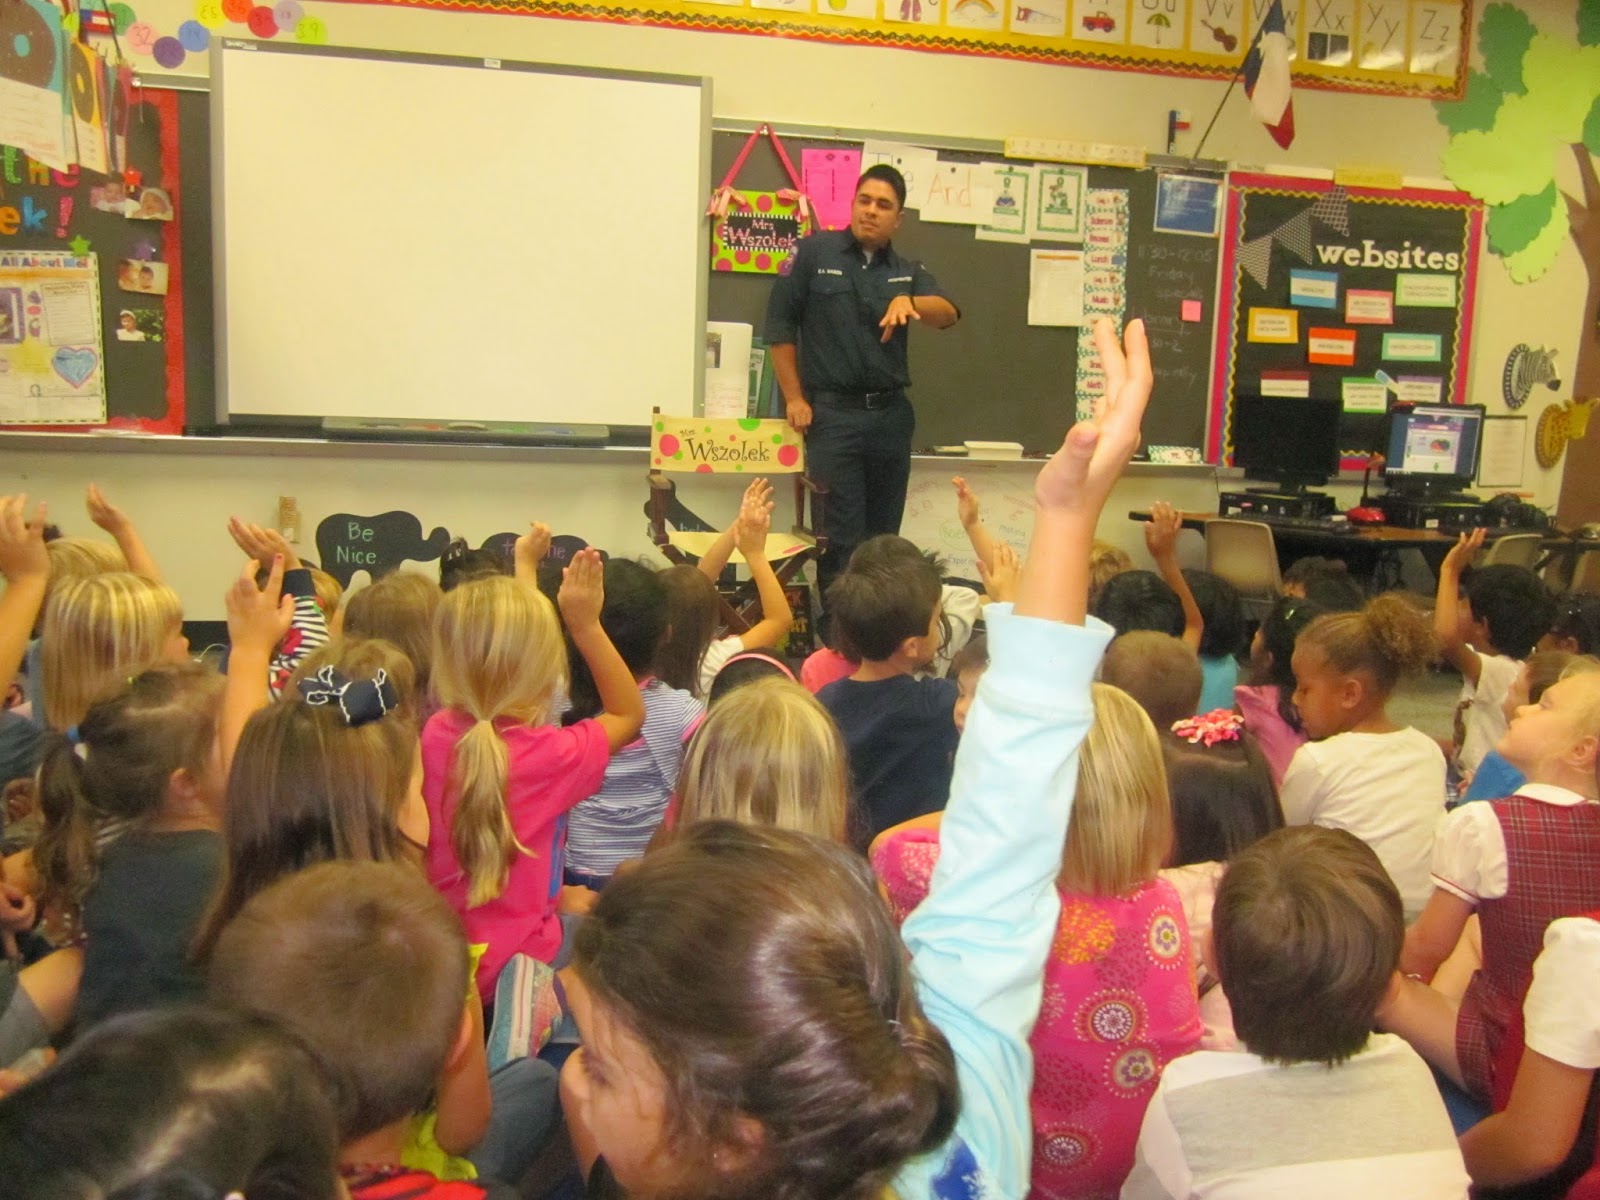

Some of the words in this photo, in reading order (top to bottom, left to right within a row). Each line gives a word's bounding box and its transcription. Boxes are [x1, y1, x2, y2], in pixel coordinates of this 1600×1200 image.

[1419, 8, 1451, 42] Zz
[752, 219, 774, 230] Mrs
[728, 226, 797, 248] Wszolek
[22, 256, 61, 268] About
[1316, 239, 1459, 271] websites
[684, 438, 770, 462] Wszolek
[348, 521, 374, 542] Be
